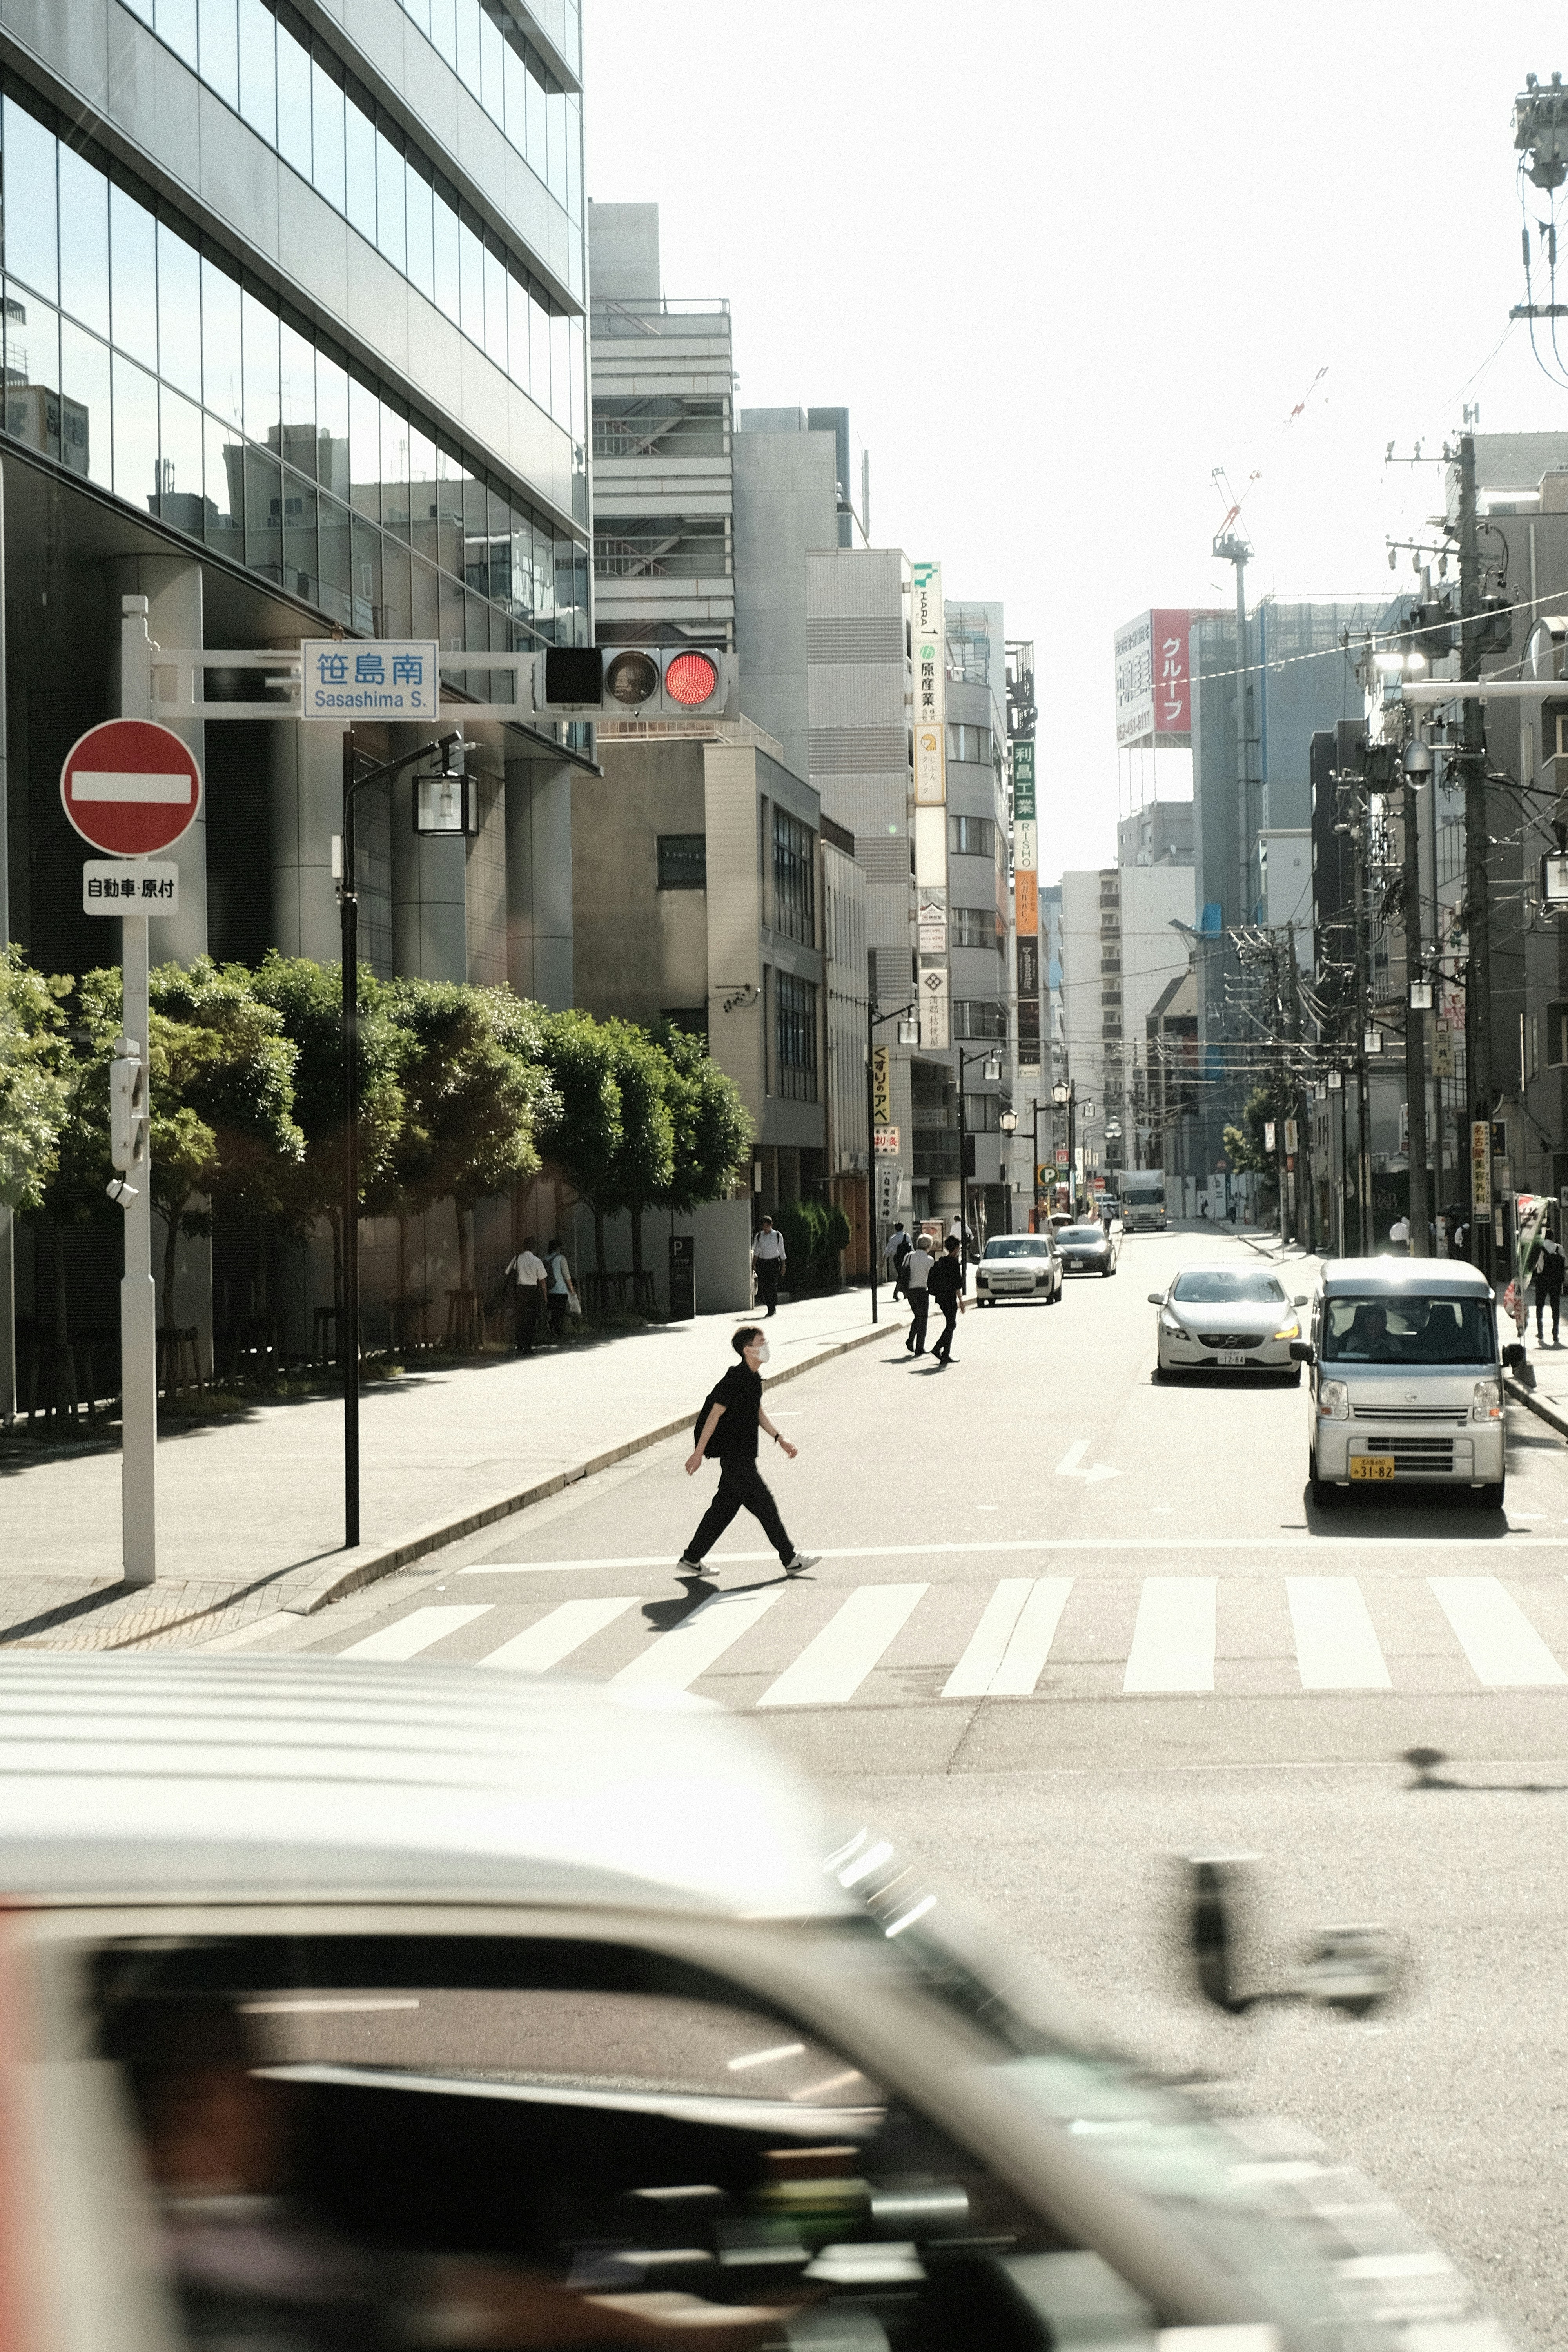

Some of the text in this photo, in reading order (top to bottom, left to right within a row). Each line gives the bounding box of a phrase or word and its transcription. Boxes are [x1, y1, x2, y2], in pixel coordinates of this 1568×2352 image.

[316, 653, 423, 686] 笹島南
[921, 663, 934, 707] 原産業
[1162, 638, 1182, 720] グループ
[314, 690, 426, 708] Sasashima S.
[1022, 823, 1031, 867] RISHO
[87, 878, 175, 898] 自動車・原付
[1022, 947, 1032, 990] b-monster
[874, 1047, 887, 1122] くすりのアベ
[1044, 1169, 1056, 1183] P
[674, 1241, 683, 1256] P
[1361, 1466, 1392, 1477] 31-82
